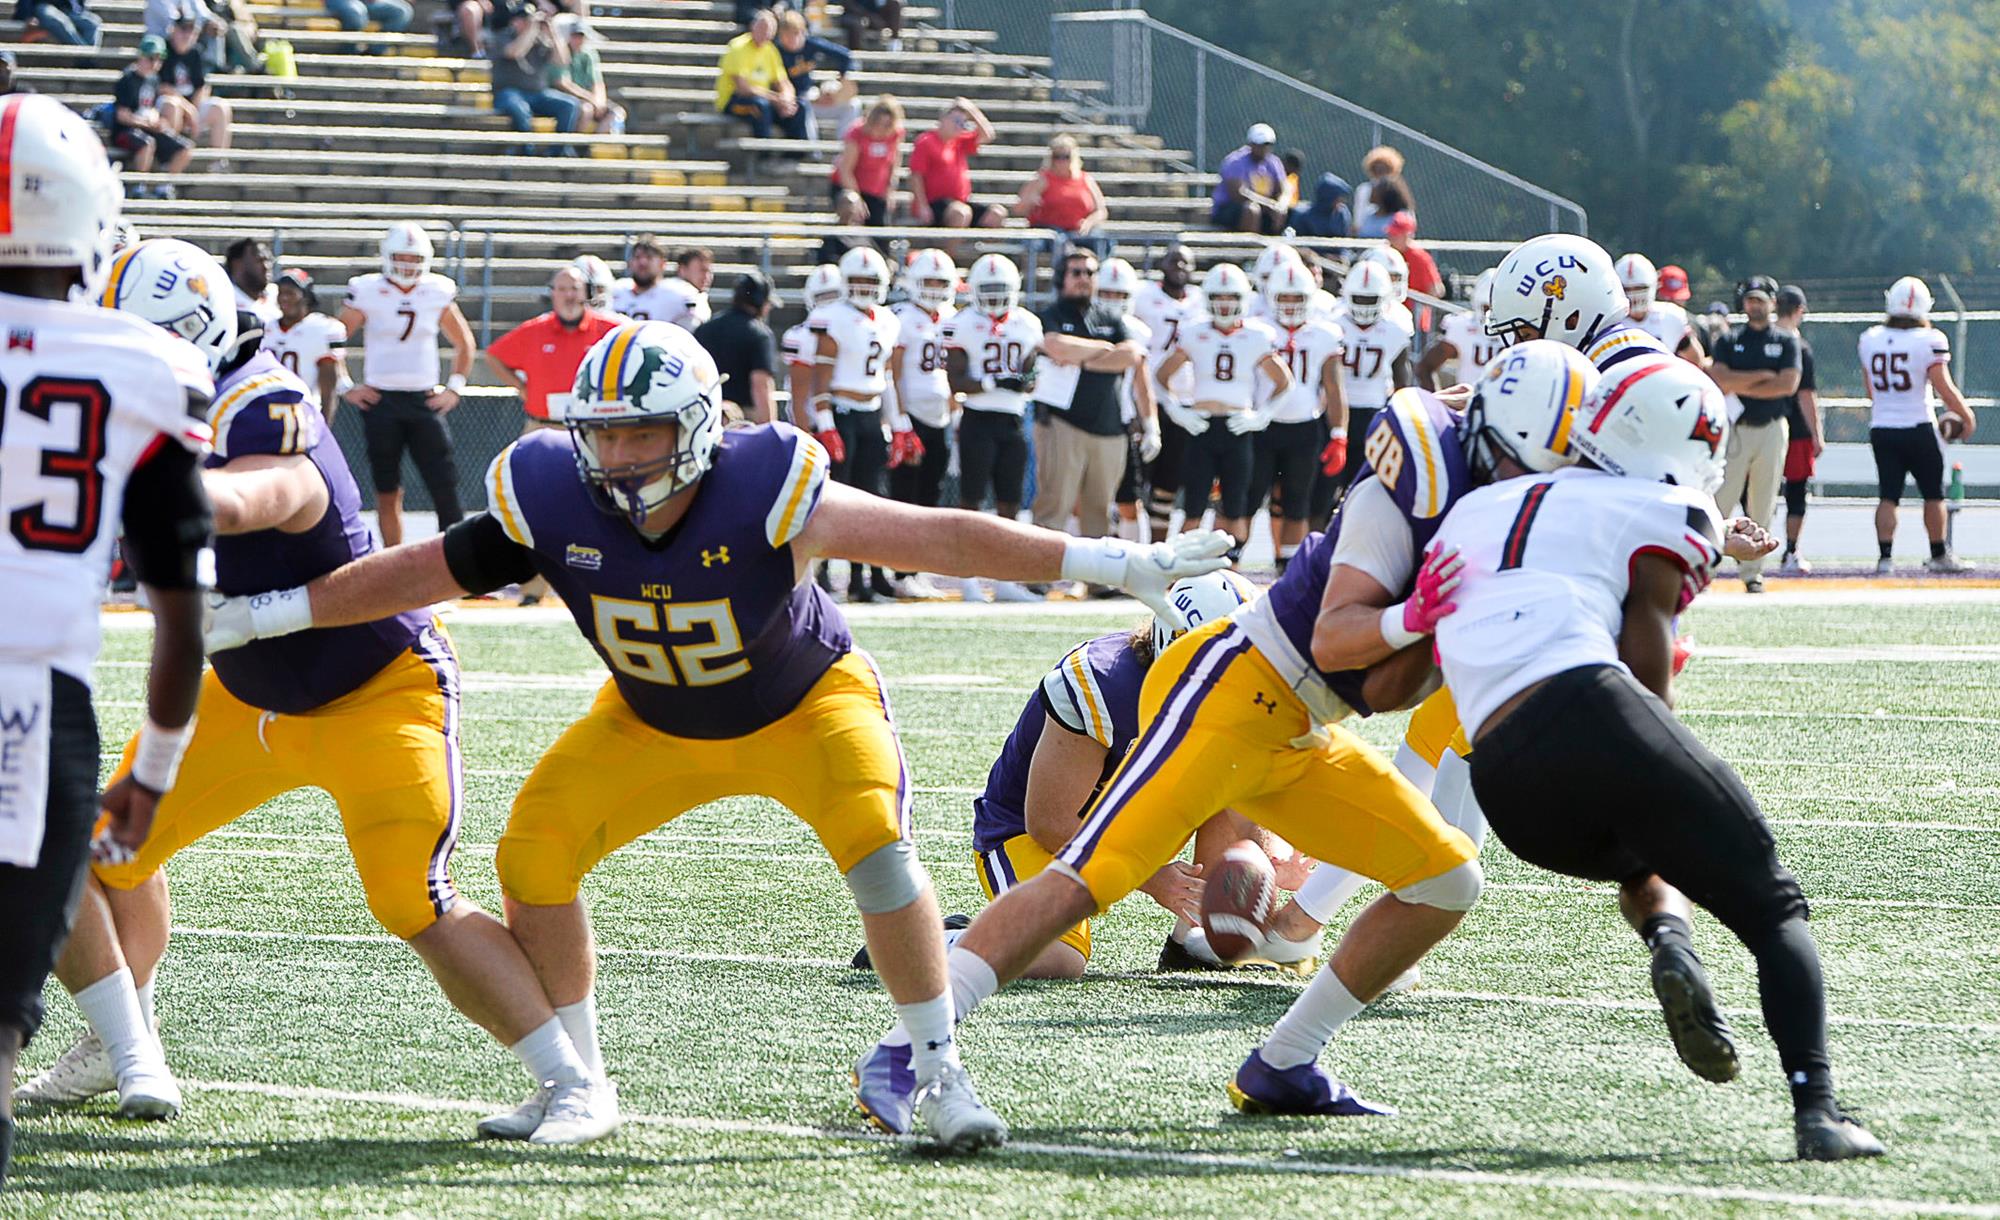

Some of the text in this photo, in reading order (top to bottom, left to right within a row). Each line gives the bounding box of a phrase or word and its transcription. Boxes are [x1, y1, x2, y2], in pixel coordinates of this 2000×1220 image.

[1516, 254, 1576, 297] WCU
[397, 310, 416, 342] 7
[865, 340, 883, 376] 2
[983, 341, 1021, 374] 20
[1215, 352, 1234, 381] 8
[1341, 345, 1383, 378] 47
[1871, 352, 1913, 392] 95
[0, 368, 113, 555] 3
[1364, 418, 1404, 491] 88
[1496, 482, 1556, 573] 1
[641, 583, 673, 600] WCU
[1175, 593, 1204, 628] WC
[589, 593, 753, 687] 62
